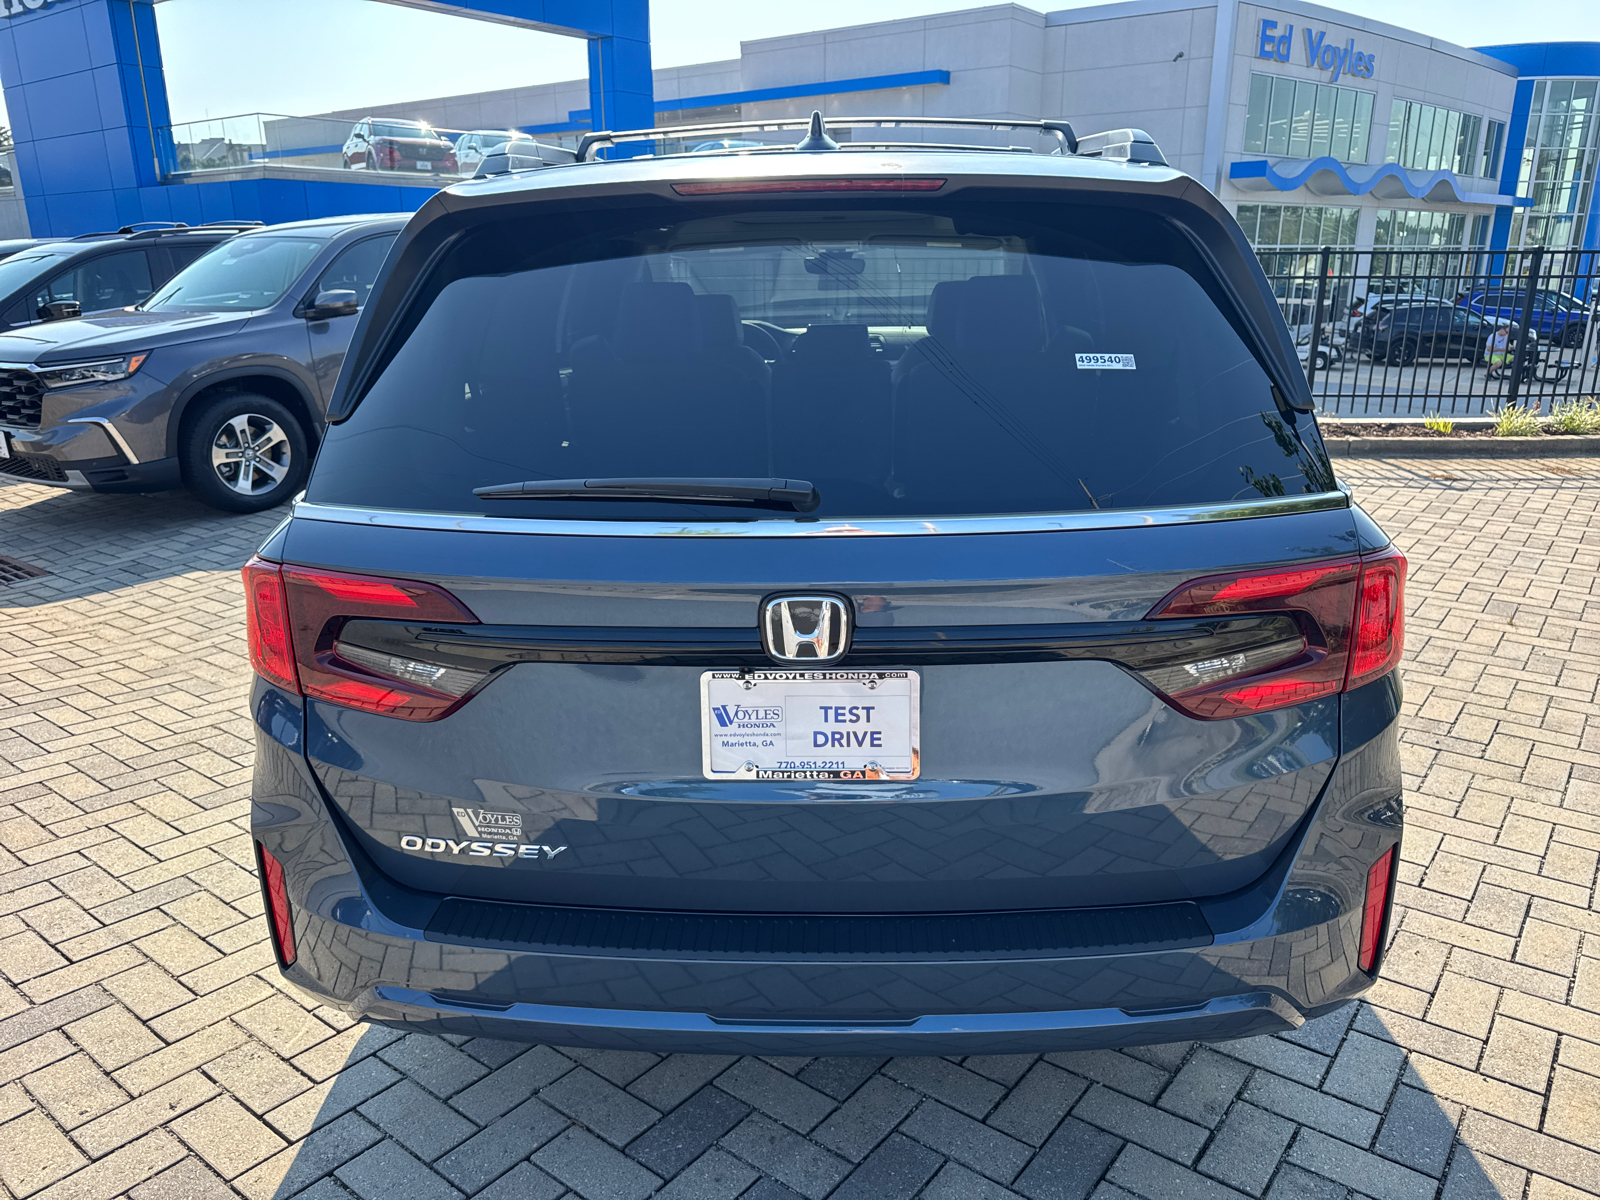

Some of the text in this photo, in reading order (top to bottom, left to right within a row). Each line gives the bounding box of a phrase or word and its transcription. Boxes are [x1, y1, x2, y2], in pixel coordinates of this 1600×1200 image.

[1259, 19, 1376, 82] Ed Voyles
[1077, 355, 1121, 364] 499540
[721, 704, 780, 726] VOYLES
[819, 705, 876, 724] TEST
[721, 740, 759, 748] Marietta,
[813, 730, 883, 748] DRIVE
[776, 761, 846, 769] 770-951-2211
[758, 770, 864, 779] Marietta, GA
[466, 808, 521, 826] VOYLES
[477, 826, 512, 834] HONDA
[481, 833, 508, 841] Marietta,
[400, 835, 568, 860] ODYSSEY
